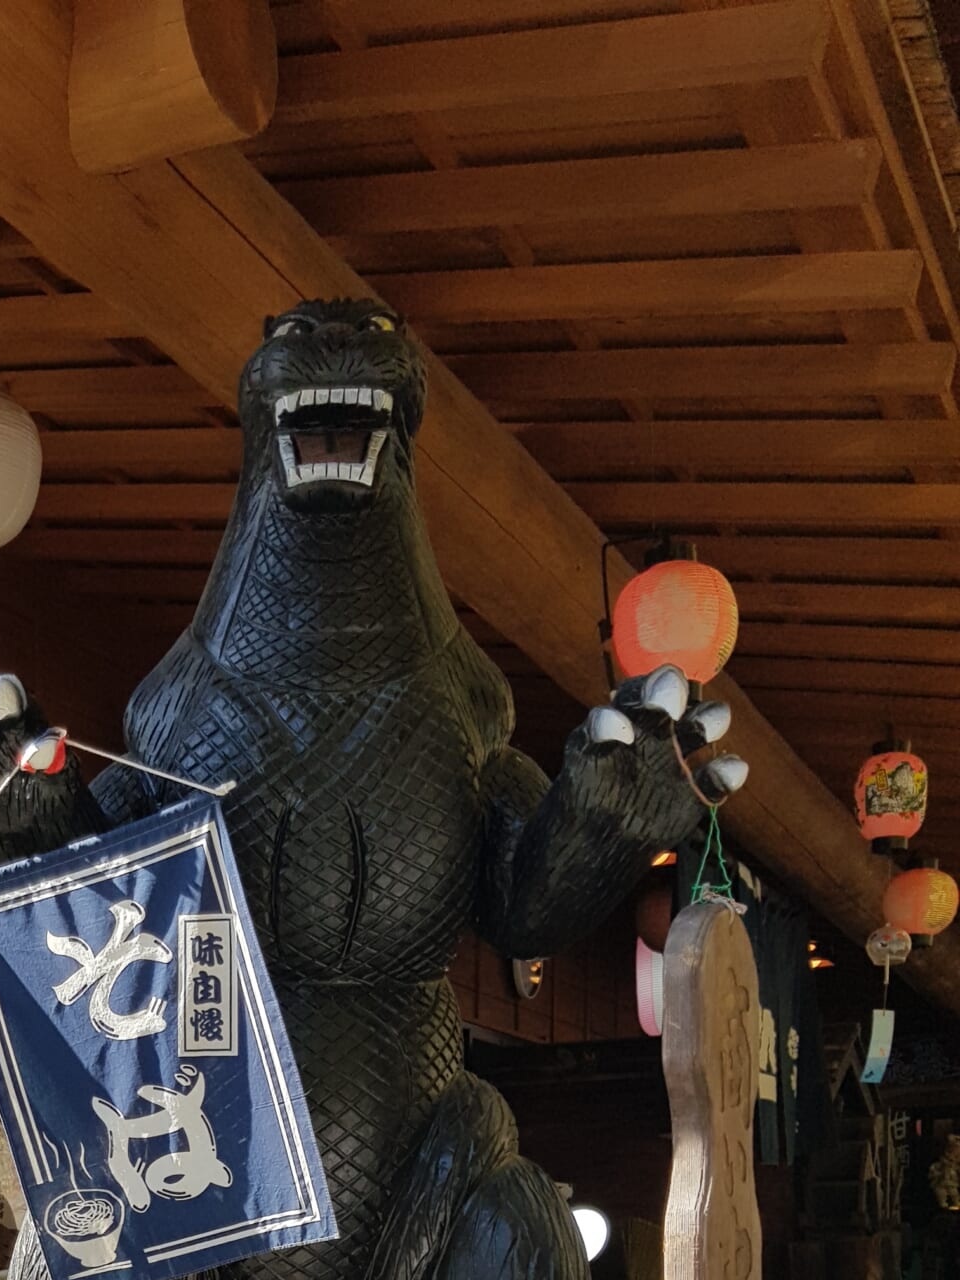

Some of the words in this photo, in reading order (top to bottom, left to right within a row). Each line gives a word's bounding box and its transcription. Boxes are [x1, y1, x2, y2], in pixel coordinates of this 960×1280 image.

[46, 899, 234, 1214] そば
[189, 932, 224, 1042] 味自慢
